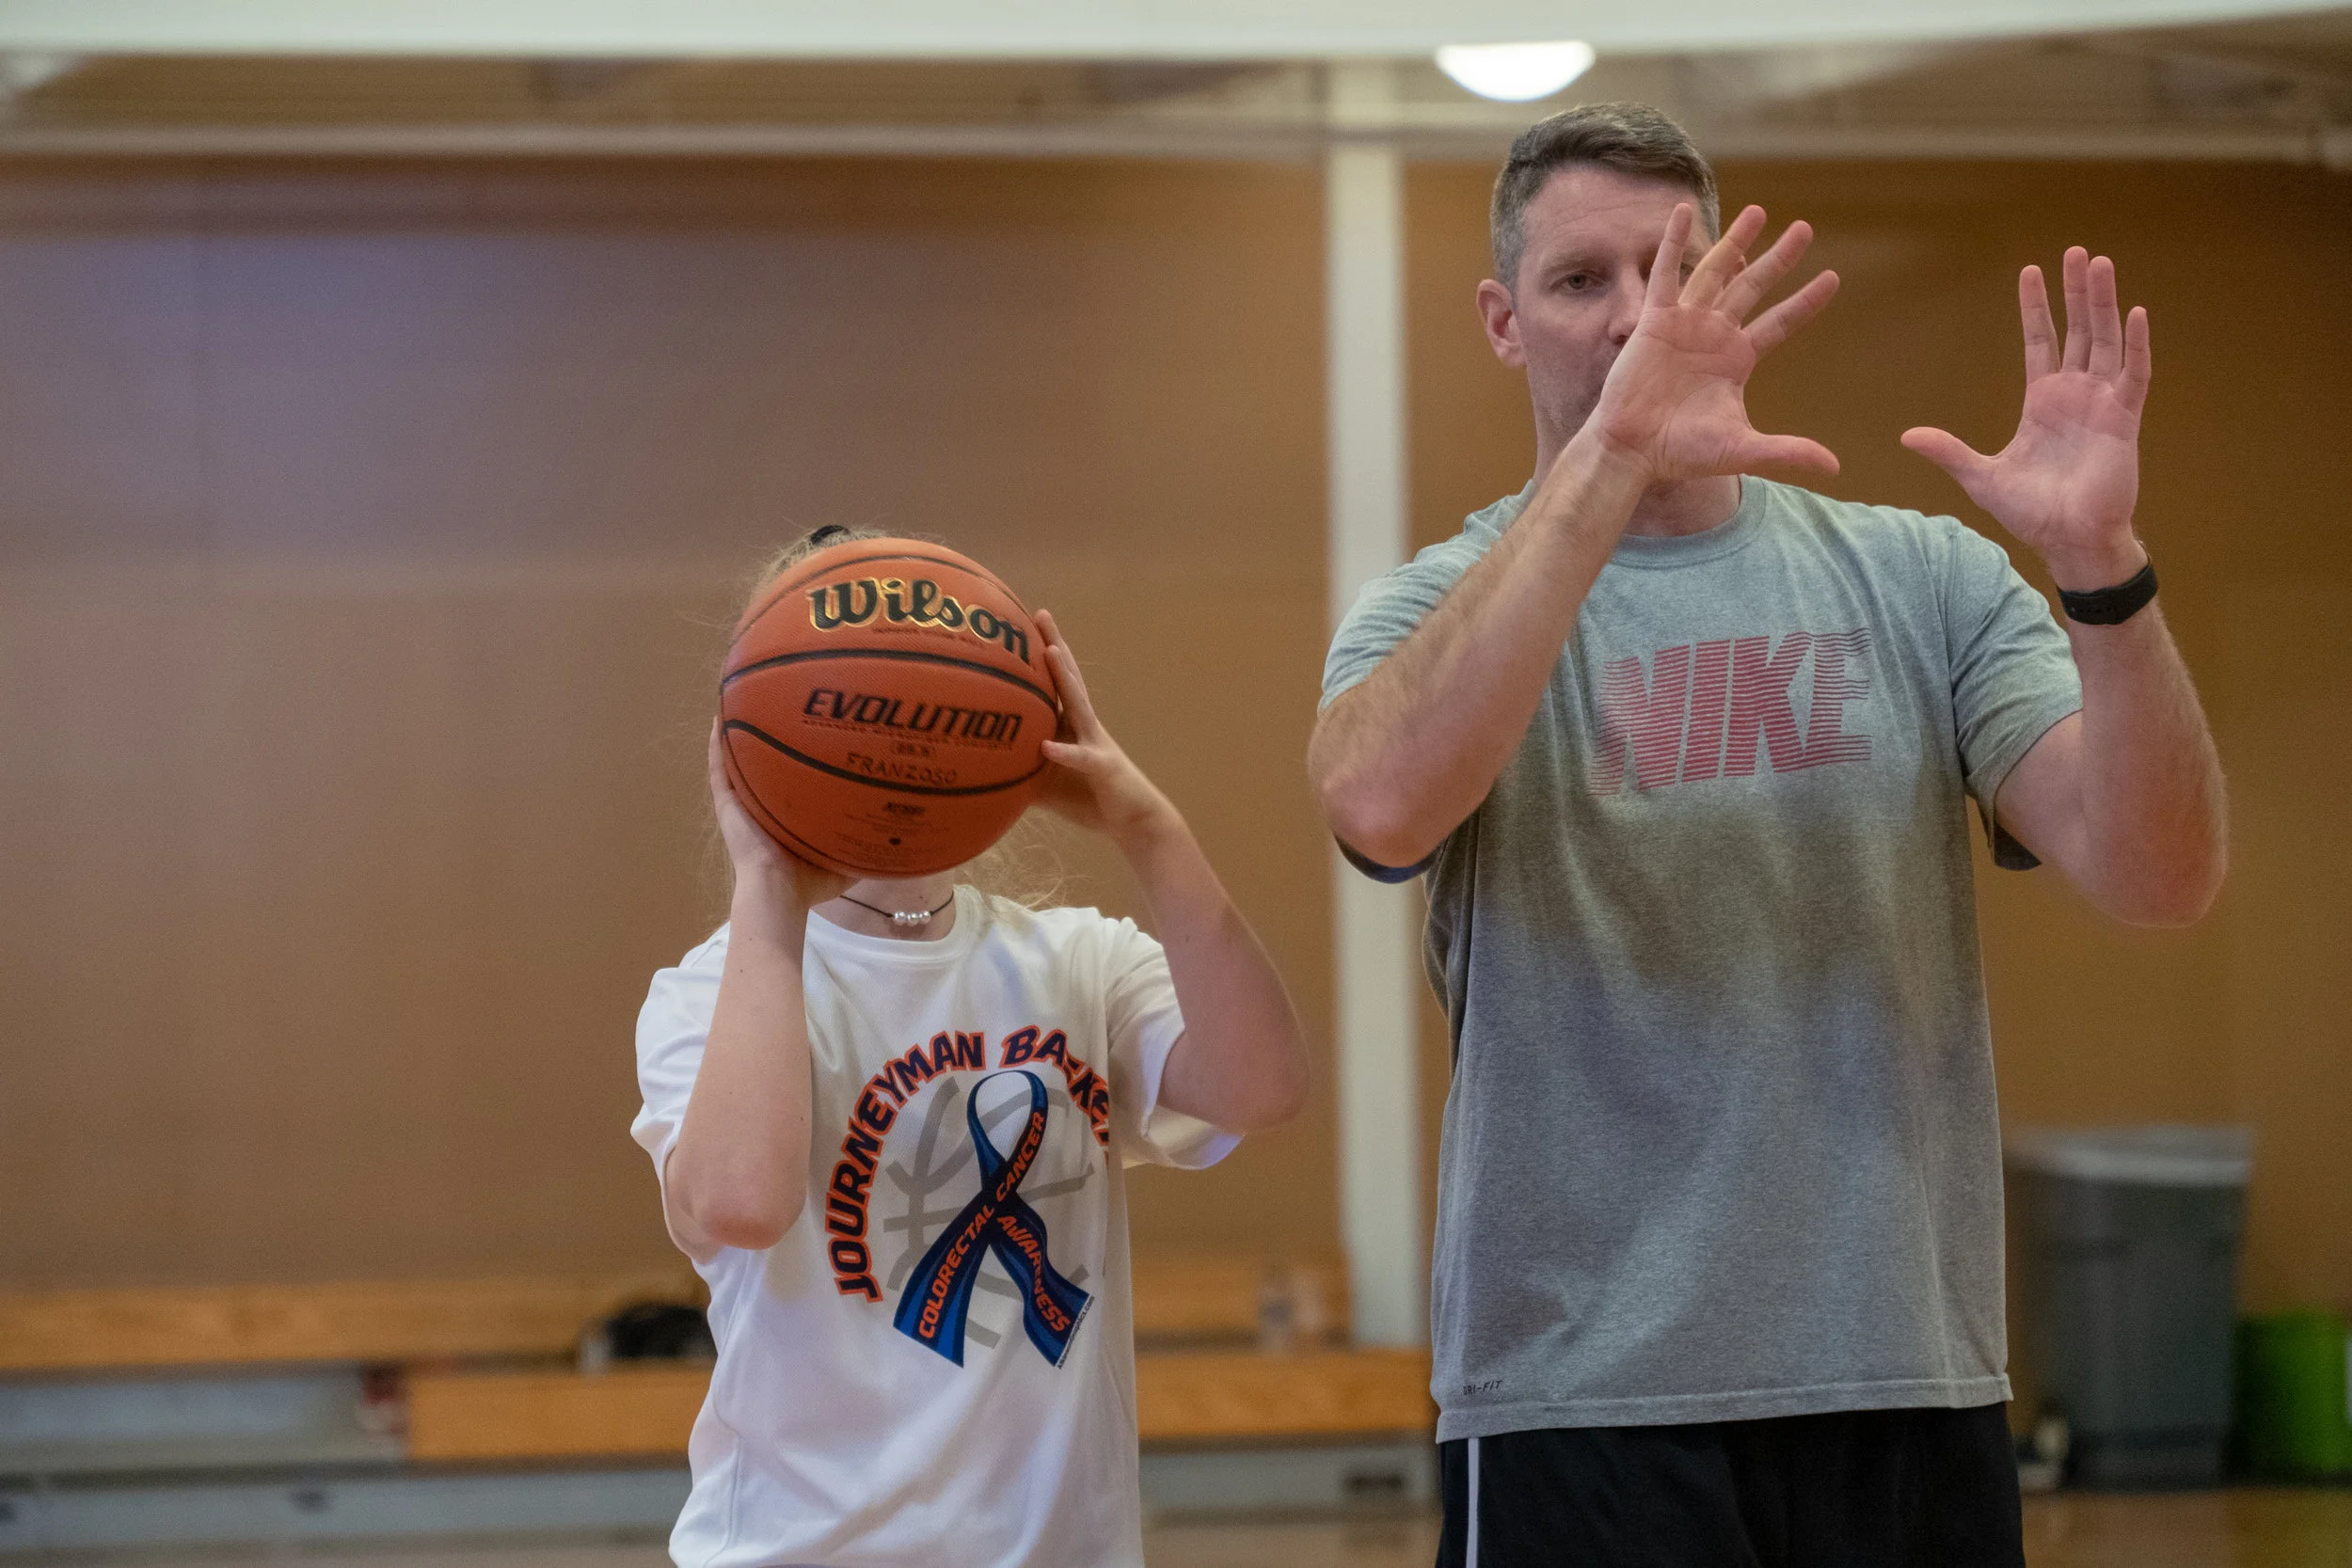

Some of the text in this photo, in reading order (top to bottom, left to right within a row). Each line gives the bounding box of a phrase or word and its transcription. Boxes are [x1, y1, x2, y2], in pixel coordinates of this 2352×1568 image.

[805, 577, 1030, 664] Wilson
[803, 688, 1024, 743] EVOLUTION
[1584, 627, 1872, 796] NIKE
[825, 1024, 1108, 1303] JOURNEYMAN BAKE
[918, 1112, 1044, 1338] COLORECTAL CANCER
[1463, 1380, 1503, 1396] DRI-FIT
